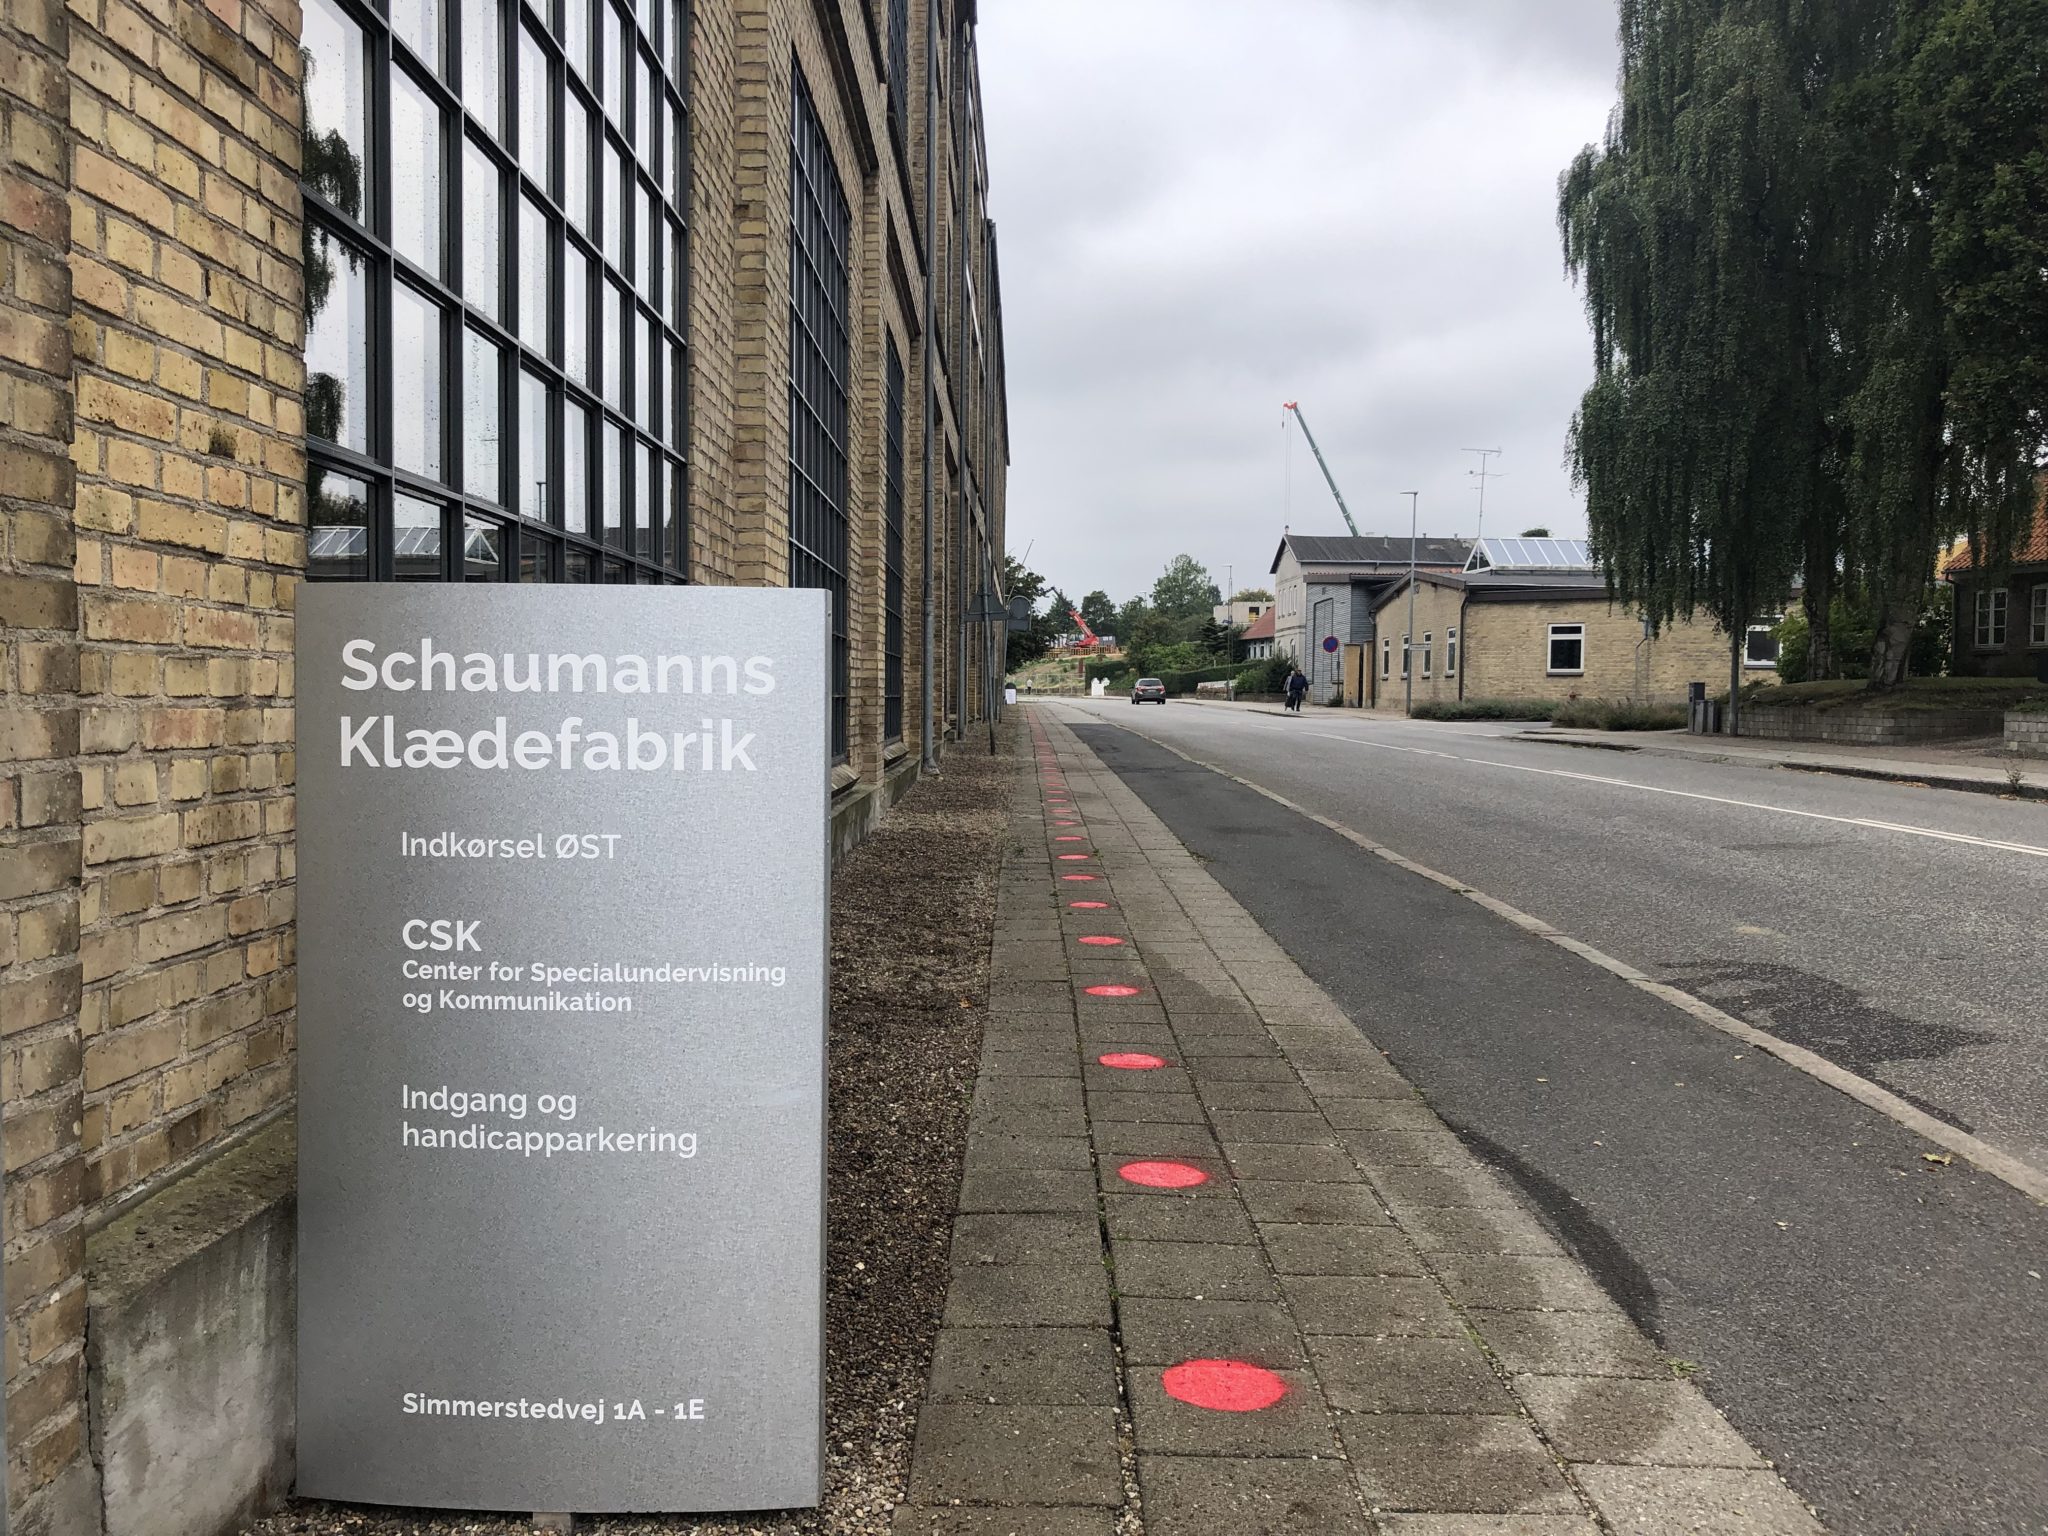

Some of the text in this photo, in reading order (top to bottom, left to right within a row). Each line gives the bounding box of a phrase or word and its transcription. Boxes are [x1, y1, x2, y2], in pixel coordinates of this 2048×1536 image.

[340, 637, 777, 695] Schaumanns
[339, 714, 758, 772] Klædefabrik
[401, 831, 622, 860] Indkørsel ØST
[402, 918, 482, 952] CSK
[402, 959, 787, 987] Center for Specialundervisning
[402, 989, 632, 1014] og Kommunikation
[402, 1084, 577, 1121] Indgang og
[402, 1120, 698, 1159] handicapparkering
[402, 1392, 605, 1425] Simmerstedvej
[613, 1398, 646, 1420] 1A
[673, 1398, 705, 1420] 1E
